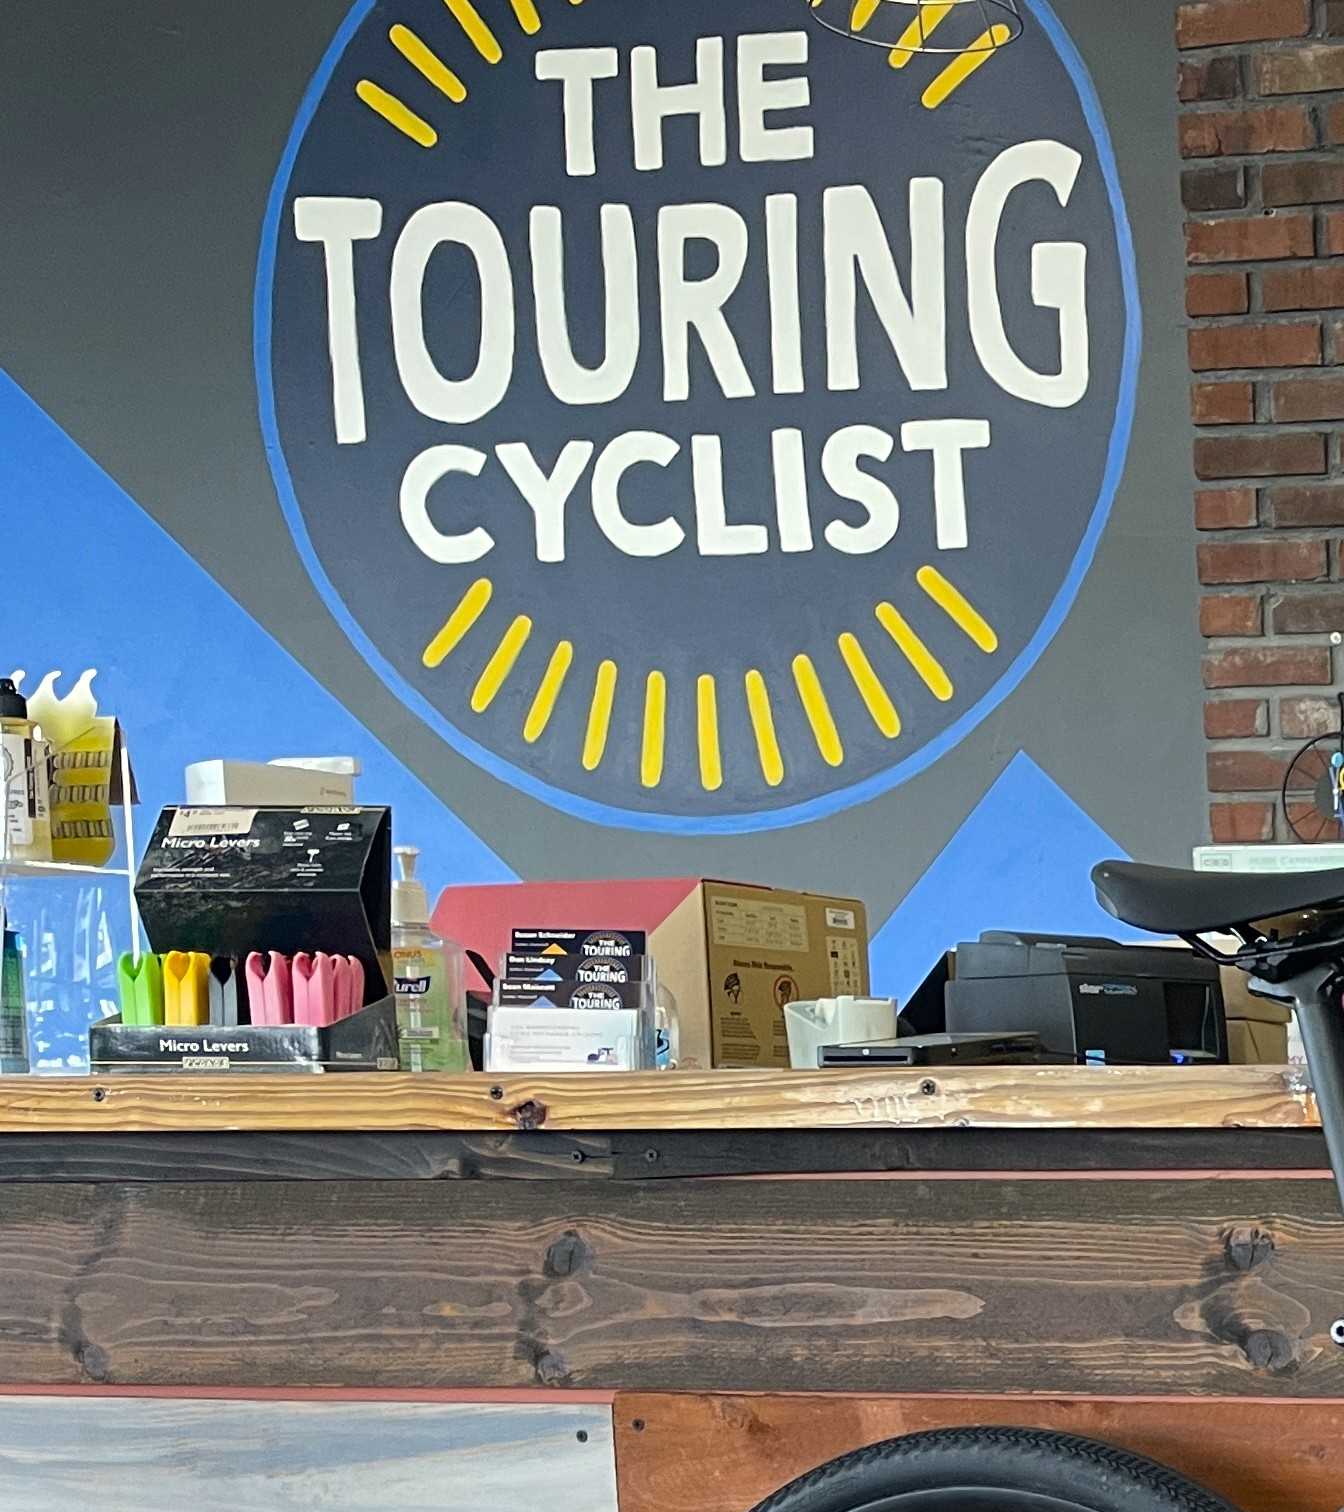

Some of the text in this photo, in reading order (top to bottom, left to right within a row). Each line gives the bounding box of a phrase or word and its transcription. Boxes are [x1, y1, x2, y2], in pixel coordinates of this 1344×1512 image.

[535, 31, 815, 176] THE
[293, 139, 1090, 445] TOURING
[399, 418, 991, 564] CYCLIST
[161, 837, 261, 849] Micro Levers
[583, 945, 632, 957] TOURING
[577, 970, 626, 984] TOURING
[573, 998, 620, 1010] TOURING
[159, 1039, 249, 1052] Micro Levers
